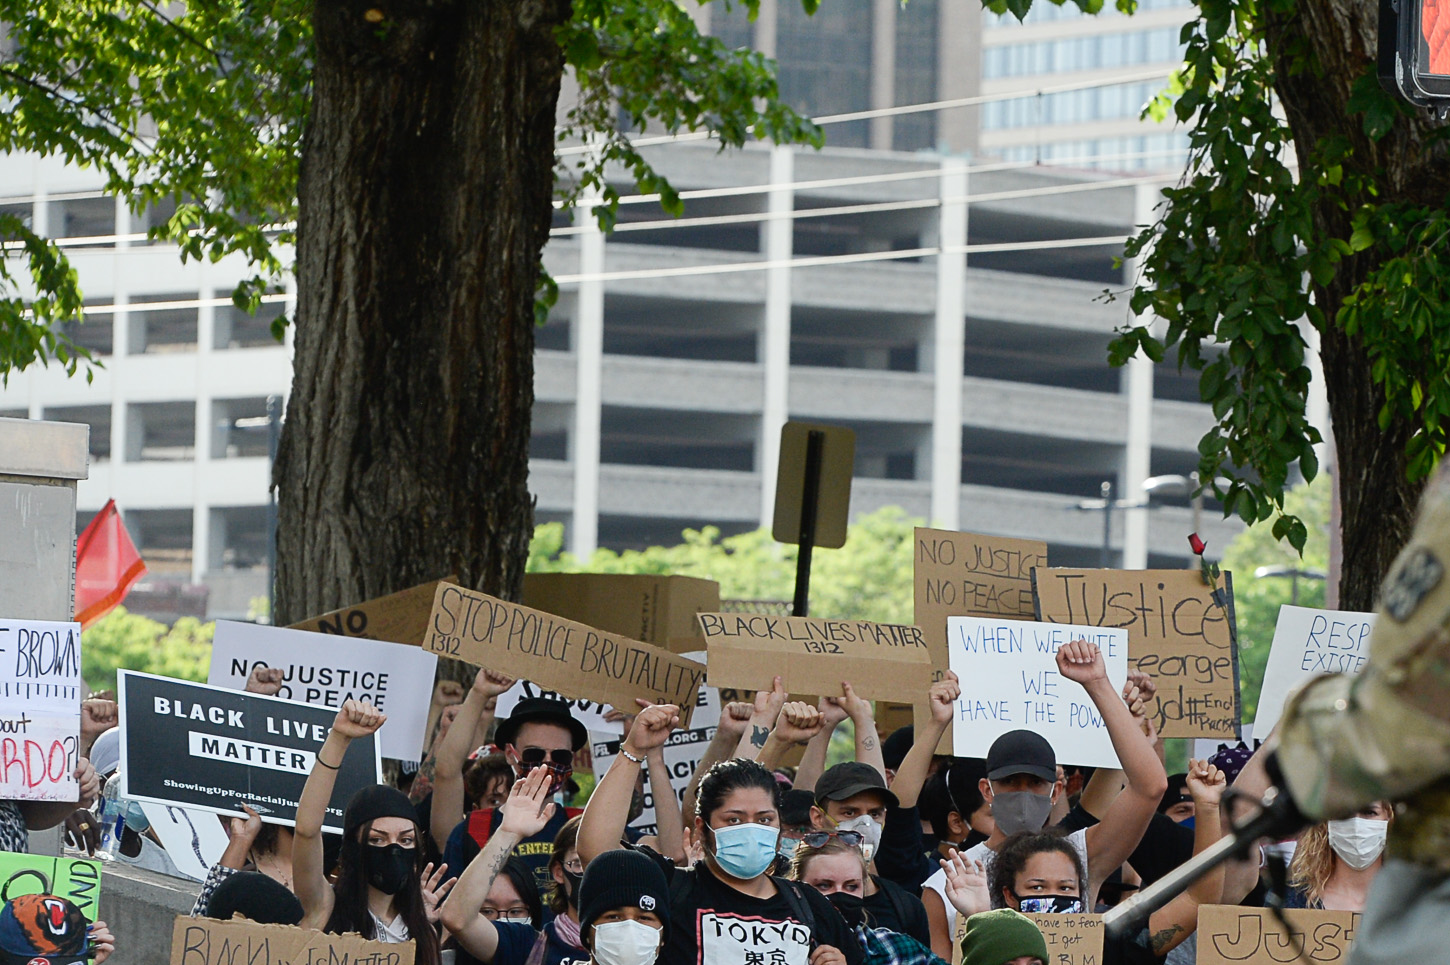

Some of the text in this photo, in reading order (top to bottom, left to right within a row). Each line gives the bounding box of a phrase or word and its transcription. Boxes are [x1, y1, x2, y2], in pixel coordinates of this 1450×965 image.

[919, 539, 956, 566] NO
[926, 578, 1034, 613] NO PEACE
[431, 633, 461, 656] 1312
[434, 587, 508, 643] STOP
[507, 608, 576, 663] POLICE
[580, 631, 701, 704] BRUTALITY
[700, 614, 928, 649] BLACK LIVES MATTER
[959, 625, 1024, 654] WHEN
[1033, 629, 1062, 653] WE
[1305, 614, 1371, 651] RESP
[16, 628, 78, 678] BROWN
[804, 640, 845, 655] 1312
[1301, 650, 1366, 674] EXISTE
[282, 664, 389, 691] JUSTICE
[1128, 653, 1231, 684] eorge
[1021, 670, 1059, 698] WE
[0, 712, 31, 734] out
[153, 696, 245, 729] BLACK
[960, 700, 1107, 729] HAVE THE POW
[0, 735, 79, 788] RDO?!
[201, 737, 307, 771] MATTER
[709, 917, 810, 947] TOKYO
[1034, 916, 1103, 930] have to fear
[1061, 932, 1084, 949] get
